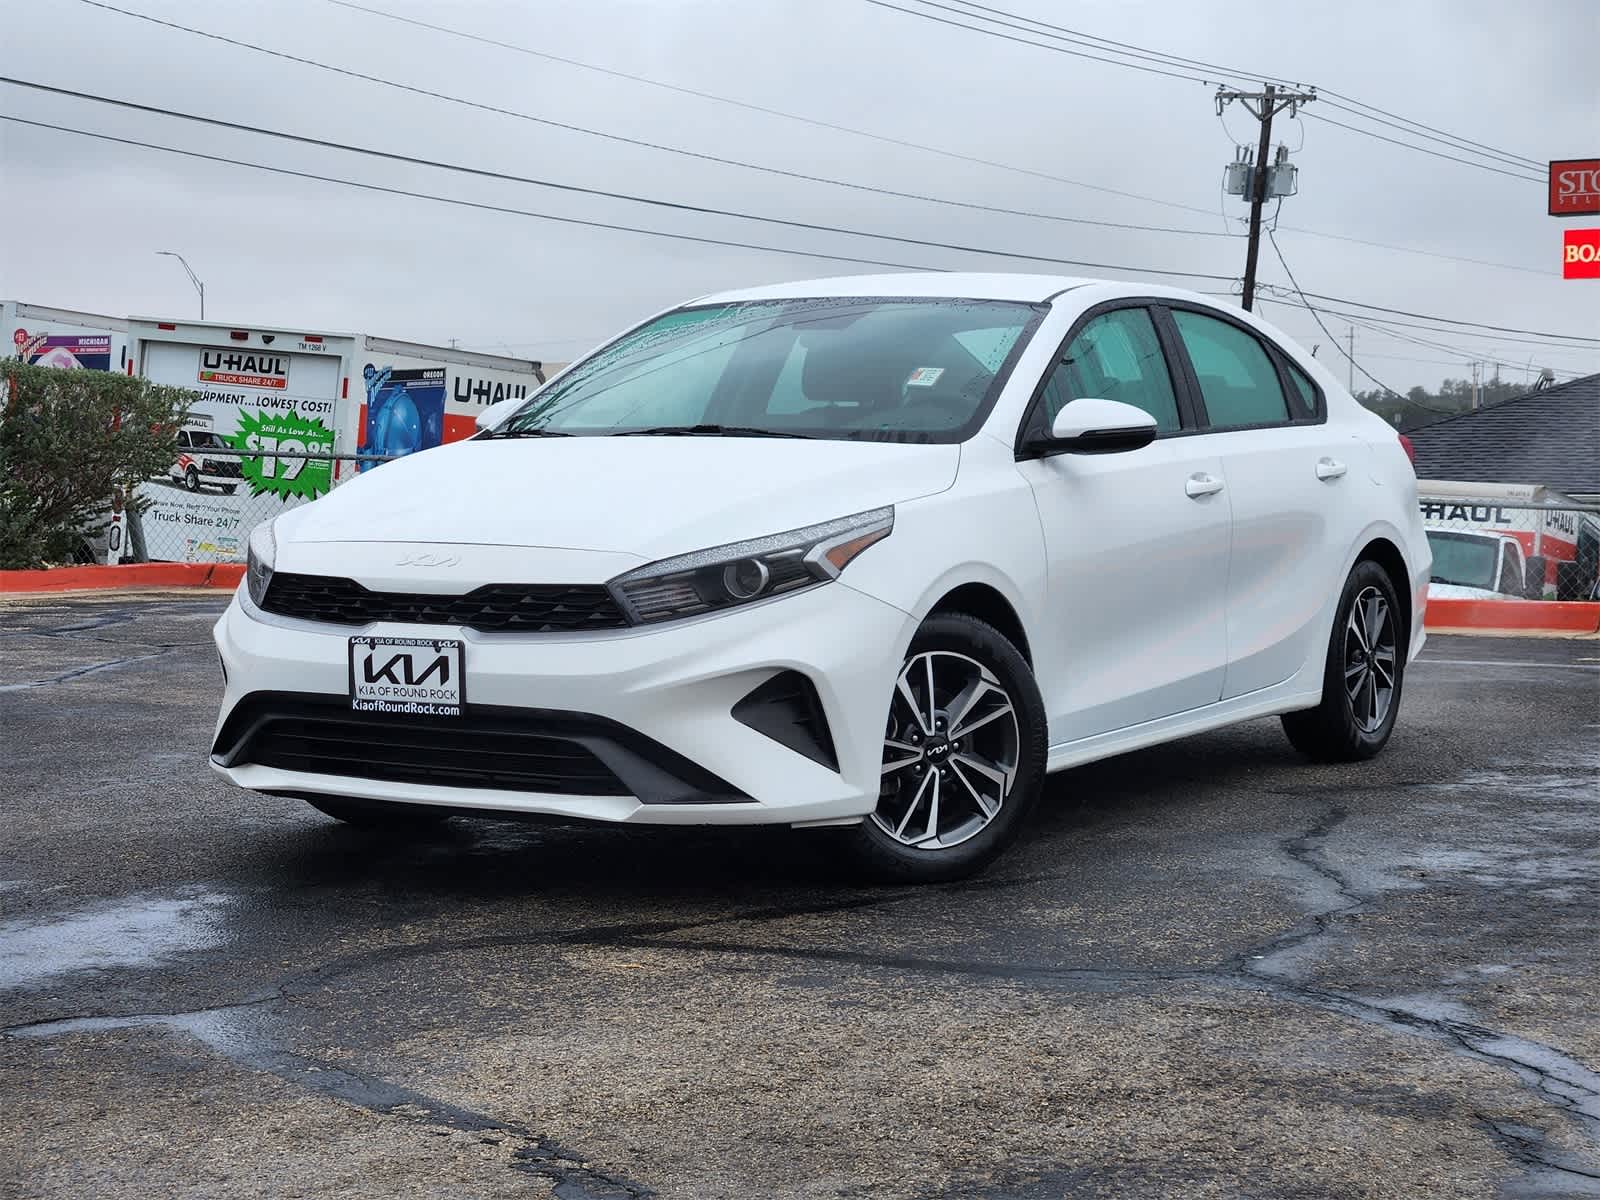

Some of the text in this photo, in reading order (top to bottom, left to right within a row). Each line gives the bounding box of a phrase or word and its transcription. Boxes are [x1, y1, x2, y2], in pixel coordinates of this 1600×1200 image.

[78, 337, 109, 346] MICHIGAN
[203, 352, 286, 376] U-HAUL
[215, 374, 238, 384] TRUCK
[238, 376, 262, 387] SHARE
[301, 400, 332, 414] COST!
[153, 510, 240, 529] Truck Share 24/7
[359, 686, 456, 700] KIA OF ROUND ROCK
[352, 699, 460, 716] KiaofRoundRock.com
